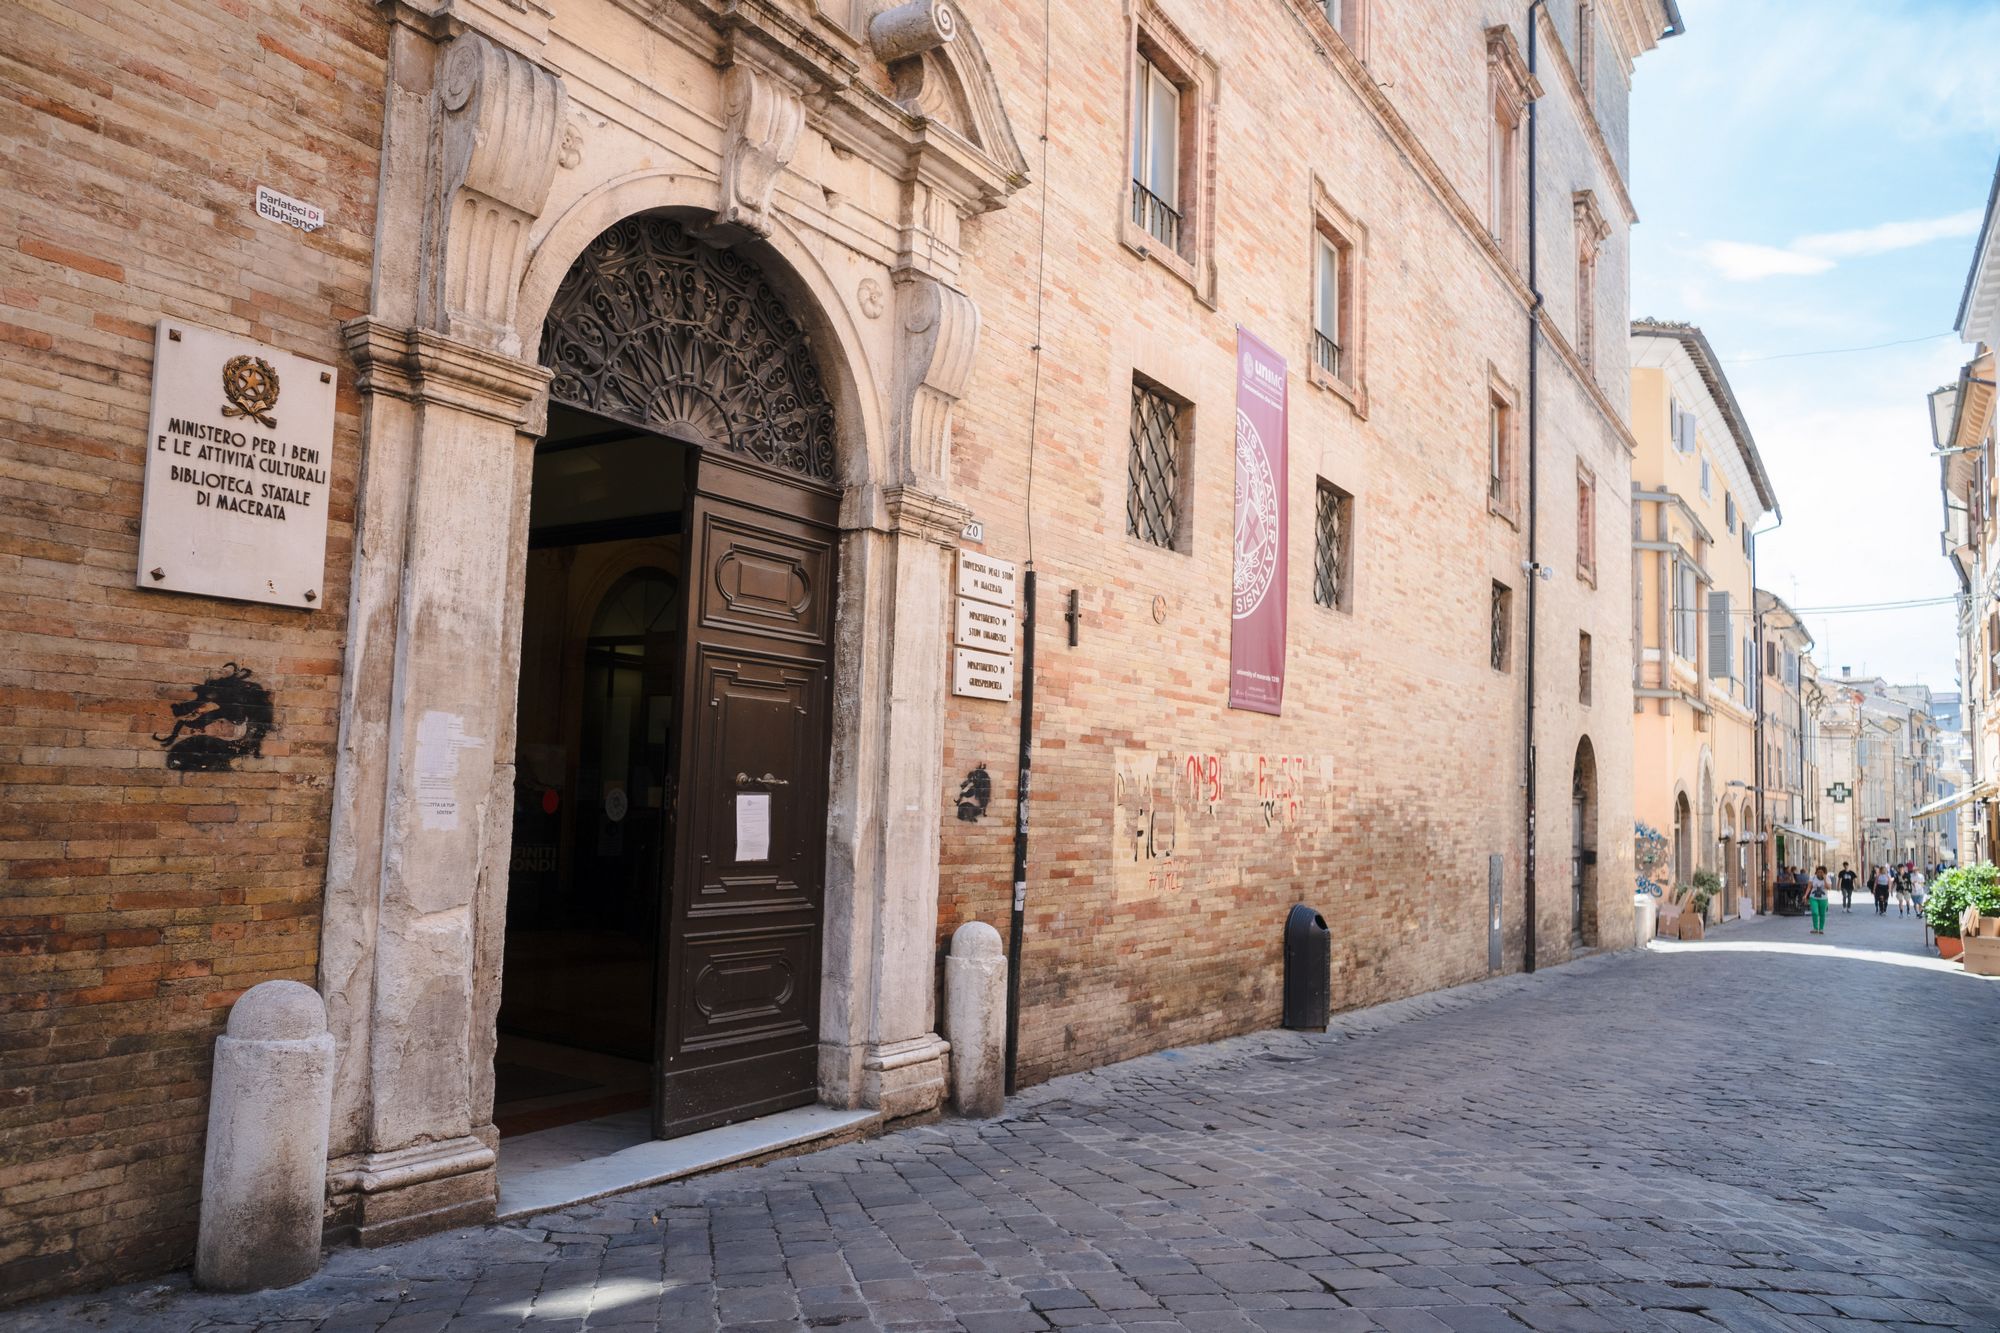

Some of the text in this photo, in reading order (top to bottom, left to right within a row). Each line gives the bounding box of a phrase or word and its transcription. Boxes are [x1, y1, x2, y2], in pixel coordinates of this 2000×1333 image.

[260, 191, 319, 221] Parlateci Di
[168, 417, 320, 465] MINISTERO PER I BENI
[157, 435, 167, 451] E
[173, 438, 192, 457] LE
[259, 458, 326, 485] CULTURALI
[170, 465, 311, 507] BIBLIOTECA STATALE
[196, 490, 286, 521] DI MACERATA
[966, 524, 979, 538] 20
